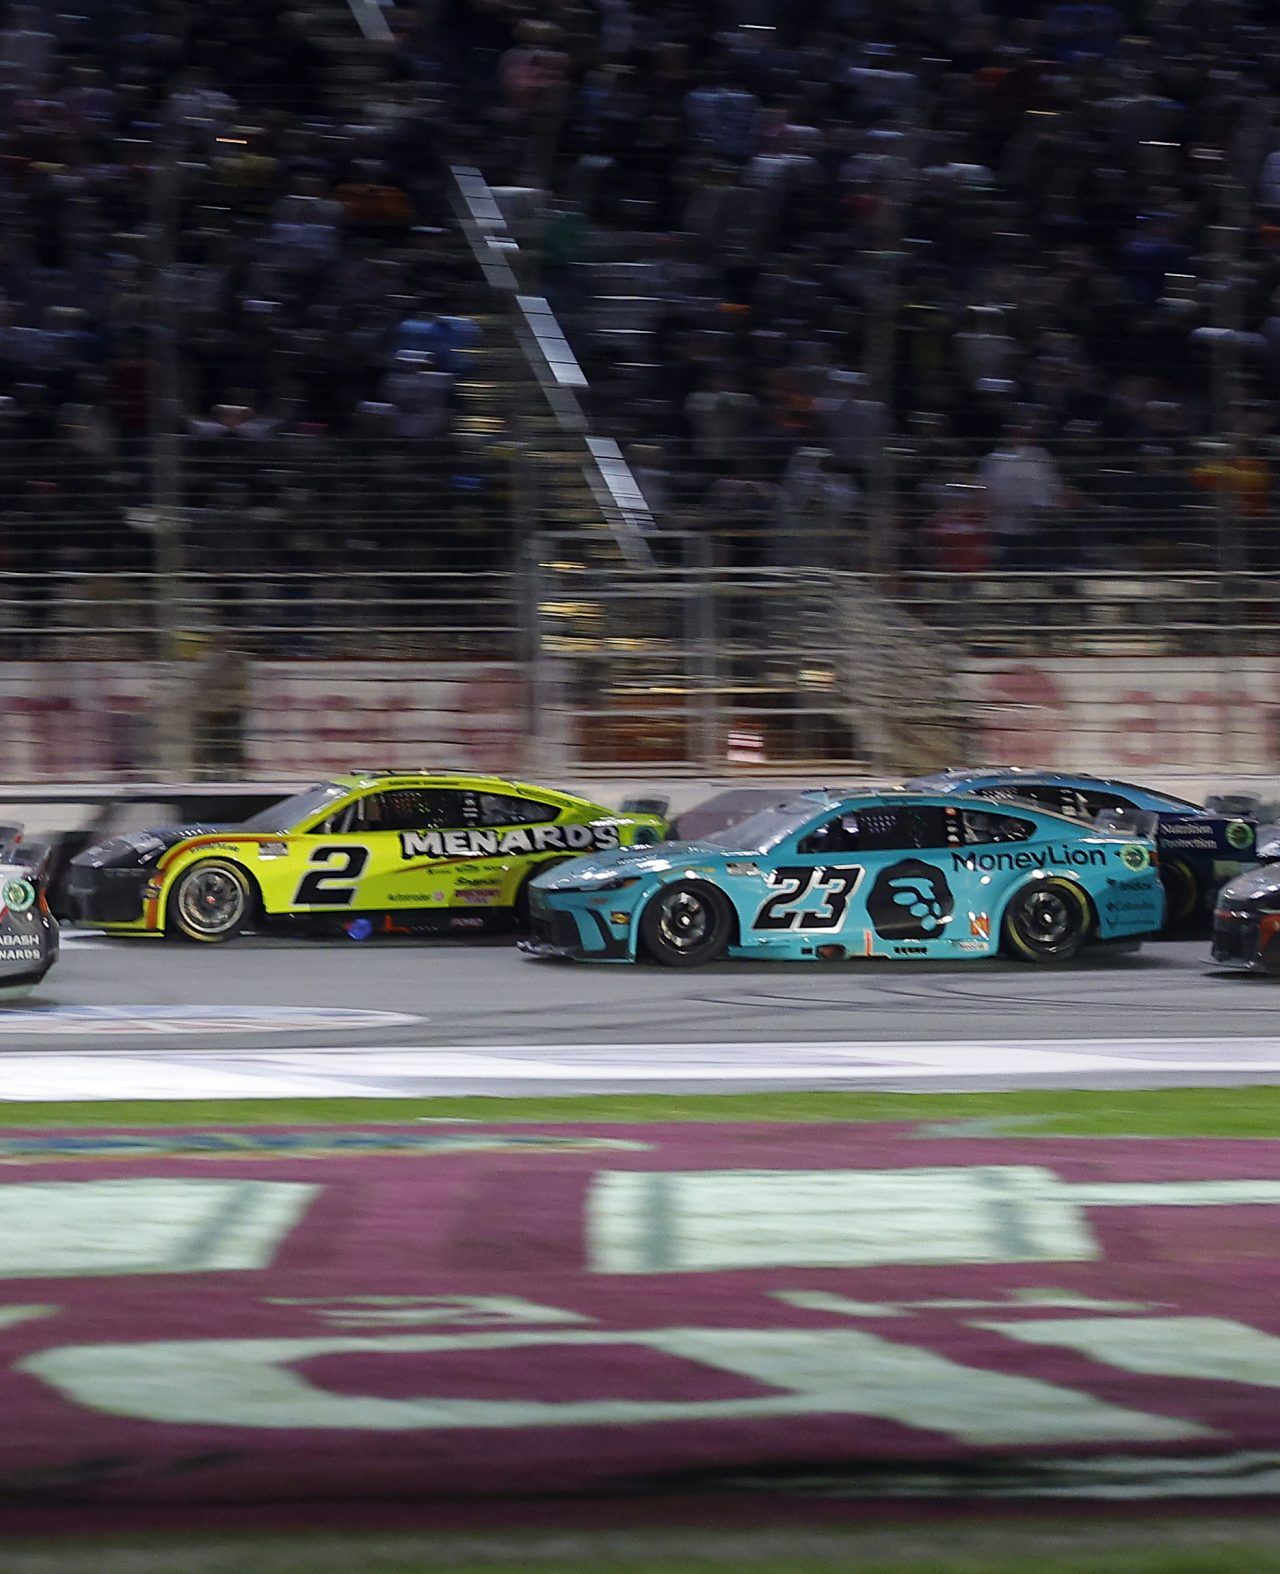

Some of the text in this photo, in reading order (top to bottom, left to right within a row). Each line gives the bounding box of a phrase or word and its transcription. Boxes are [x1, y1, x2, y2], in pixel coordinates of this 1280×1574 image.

[400, 823, 619, 860] MENARDS
[950, 844, 1107, 873] MoneyLion
[292, 844, 370, 906] 2
[752, 864, 866, 934] 23
